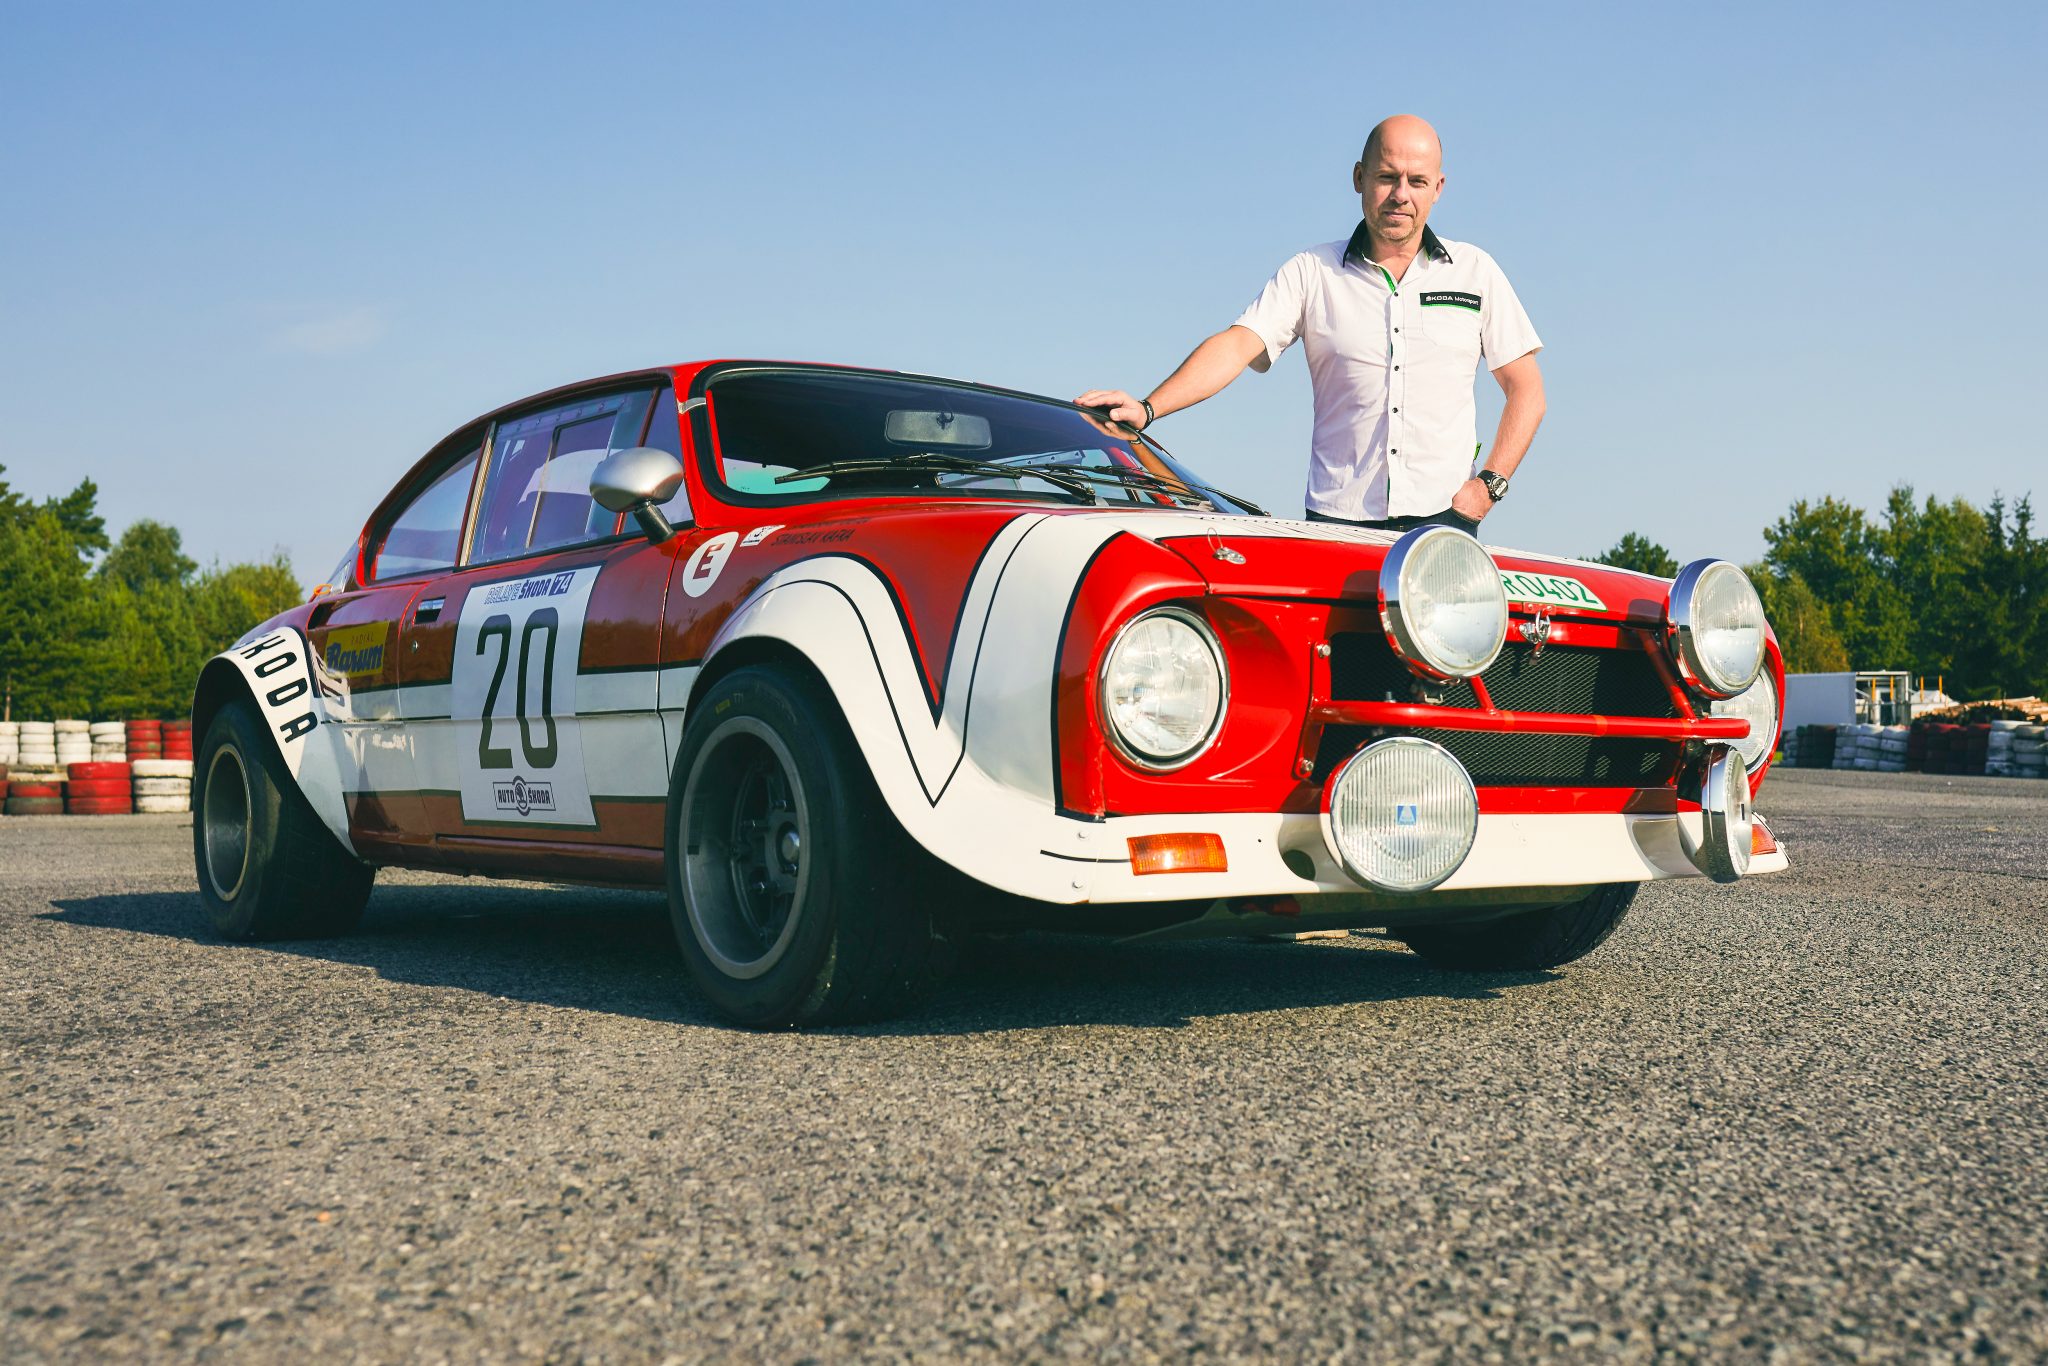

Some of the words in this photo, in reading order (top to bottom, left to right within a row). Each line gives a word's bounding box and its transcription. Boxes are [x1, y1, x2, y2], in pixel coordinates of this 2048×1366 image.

[1454, 296, 1479, 305] Motorsport
[692, 543, 726, 580] E
[518, 579, 552, 600] ŠKODA
[476, 607, 559, 769] 20
[497, 789, 515, 803] AUTO
[528, 787, 551, 804] ŠKODA
